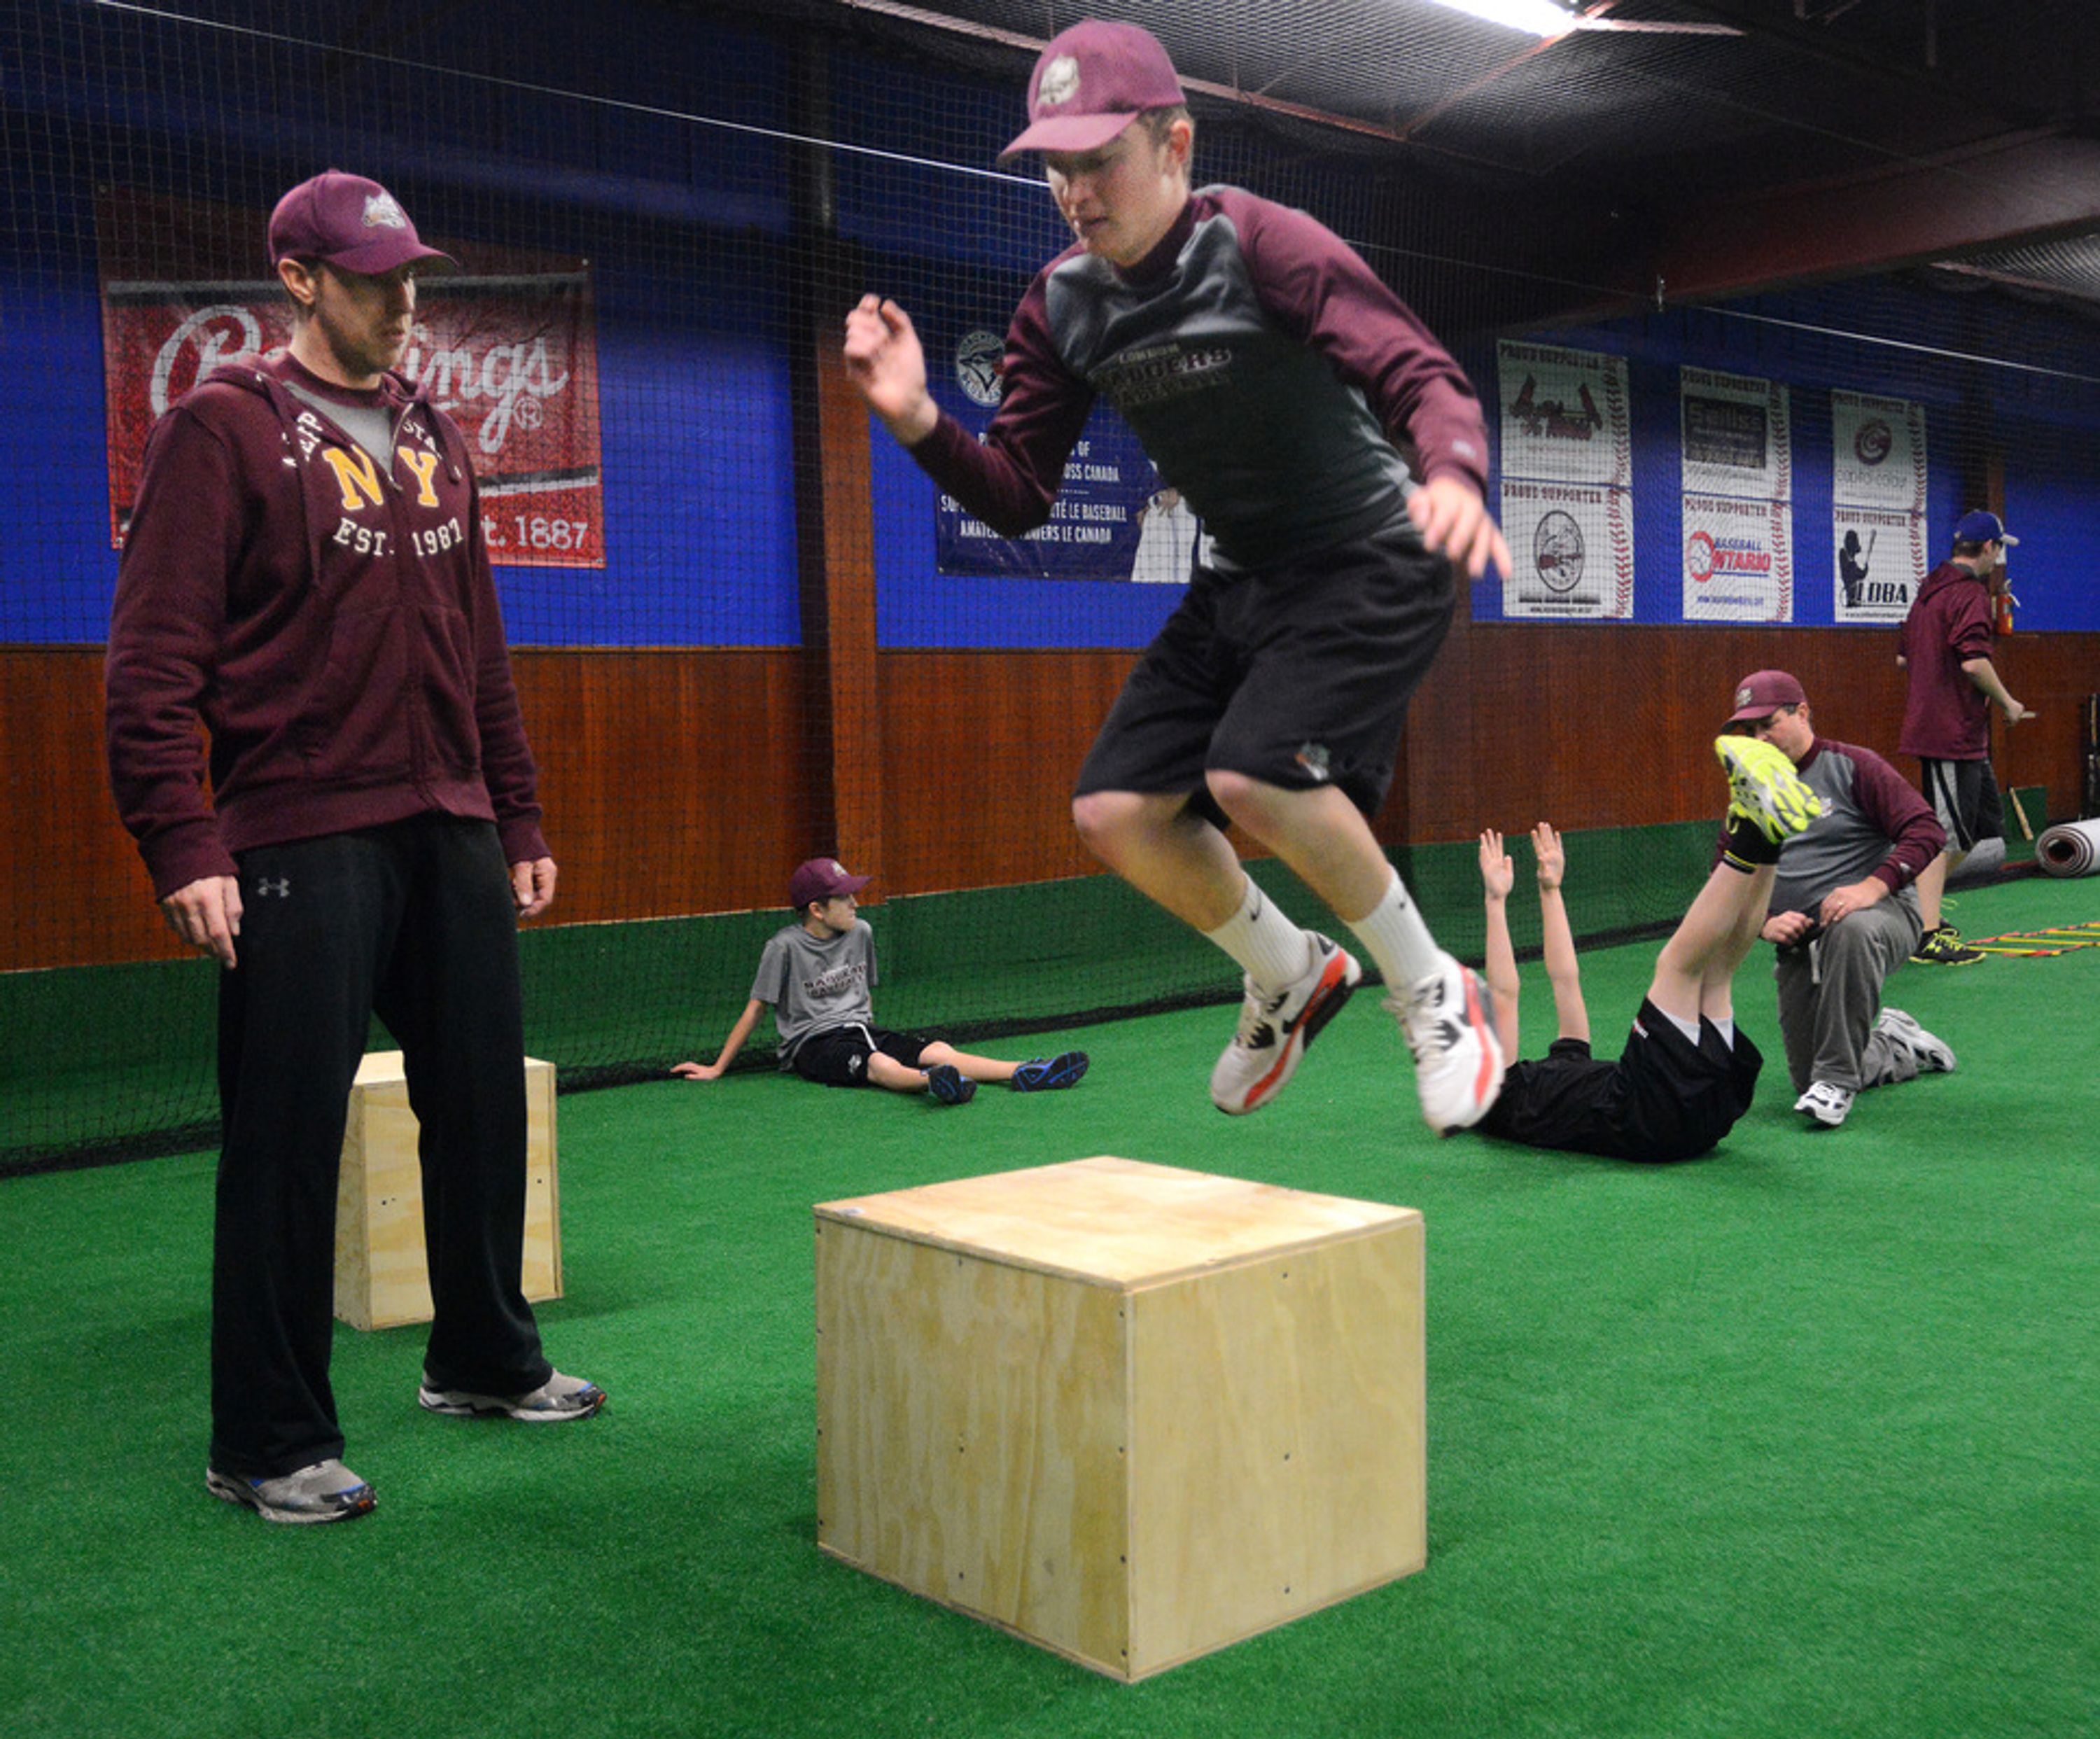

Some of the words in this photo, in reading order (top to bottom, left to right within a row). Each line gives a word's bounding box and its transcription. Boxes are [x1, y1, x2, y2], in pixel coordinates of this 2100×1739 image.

[150, 305, 569, 454] Rings
[1085, 463, 1120, 482] CANADA
[1504, 483, 1539, 499] PROUD
[1541, 487, 1602, 504] SUPPORTER
[1069, 502, 1081, 519] LE
[1082, 503, 1128, 522] BASEBALL
[332, 516, 394, 557] EST.
[412, 516, 464, 557] 1987
[515, 515, 589, 550] 1887
[1062, 527, 1073, 543] LE
[1074, 526, 1112, 544] CANADA
[1714, 537, 1763, 551] BASEBALL
